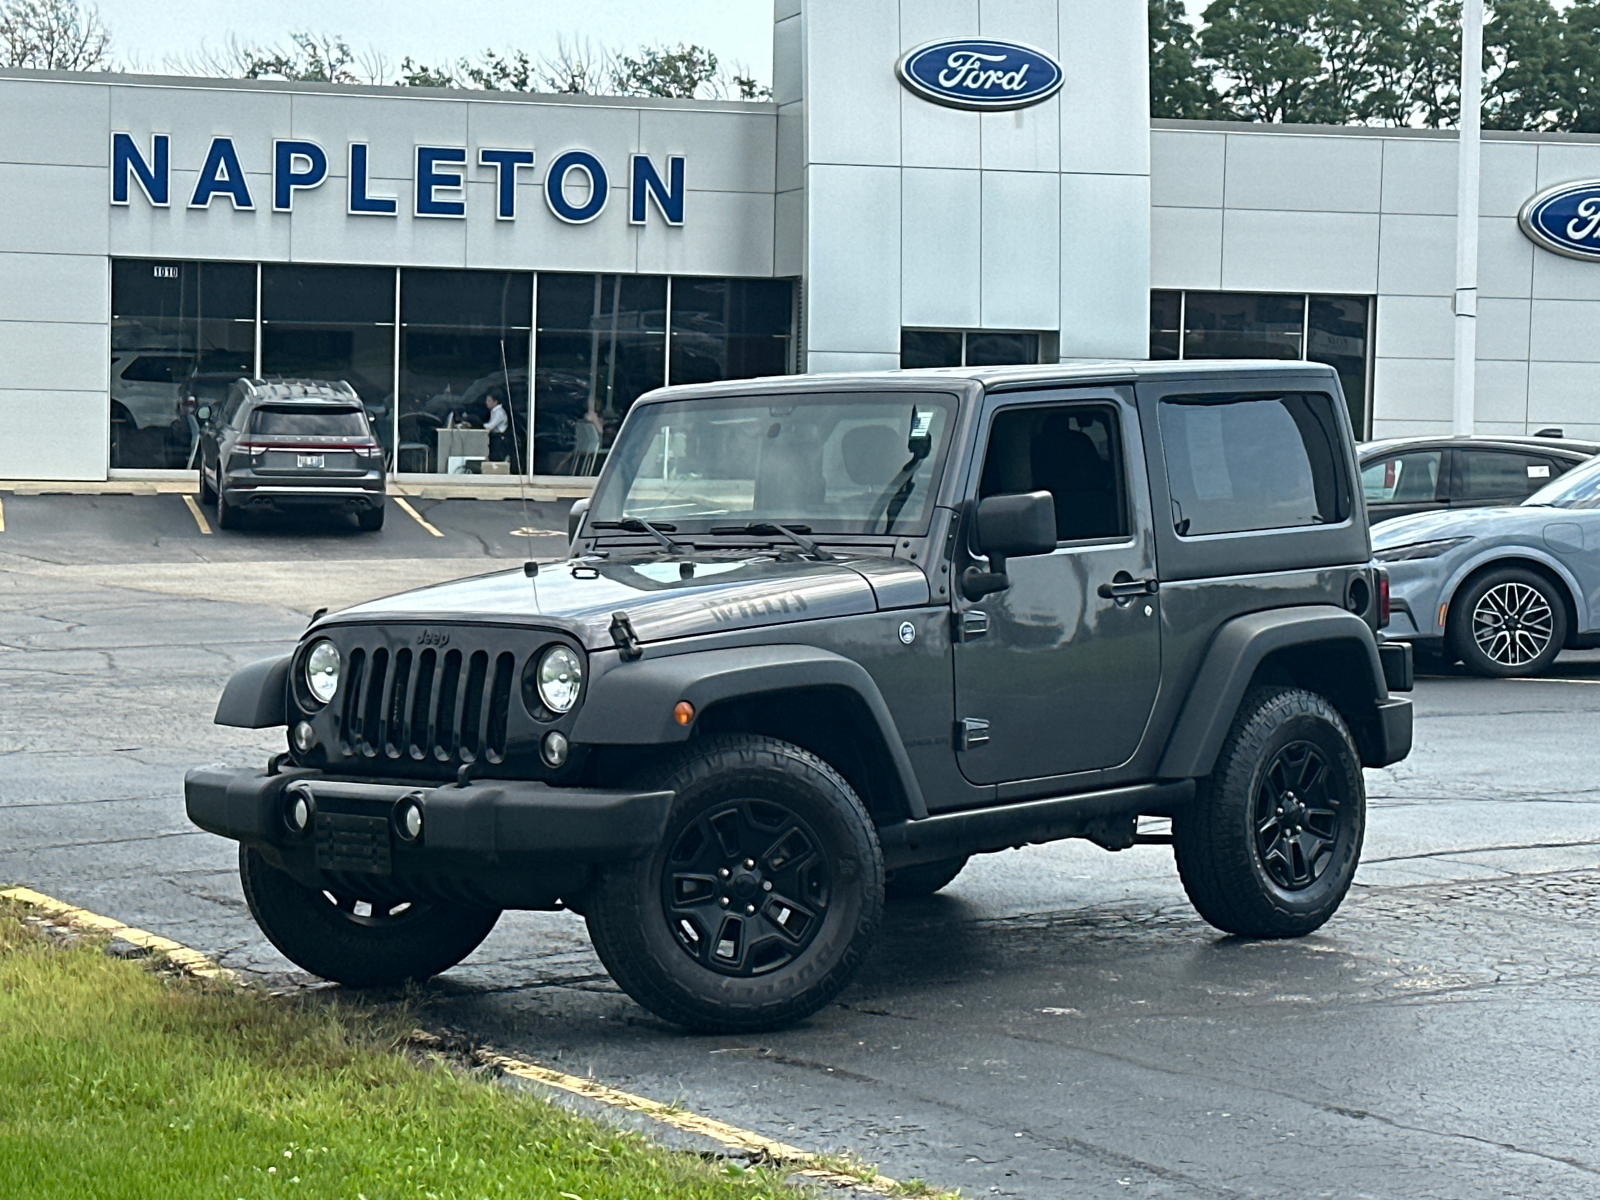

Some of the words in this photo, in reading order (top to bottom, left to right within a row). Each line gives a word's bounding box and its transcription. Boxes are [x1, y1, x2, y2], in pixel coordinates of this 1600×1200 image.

[938, 51, 1030, 90] Ford
[110, 131, 686, 227] NAPLETON
[155, 266, 178, 278] 1010
[416, 628, 450, 648] Jeep
